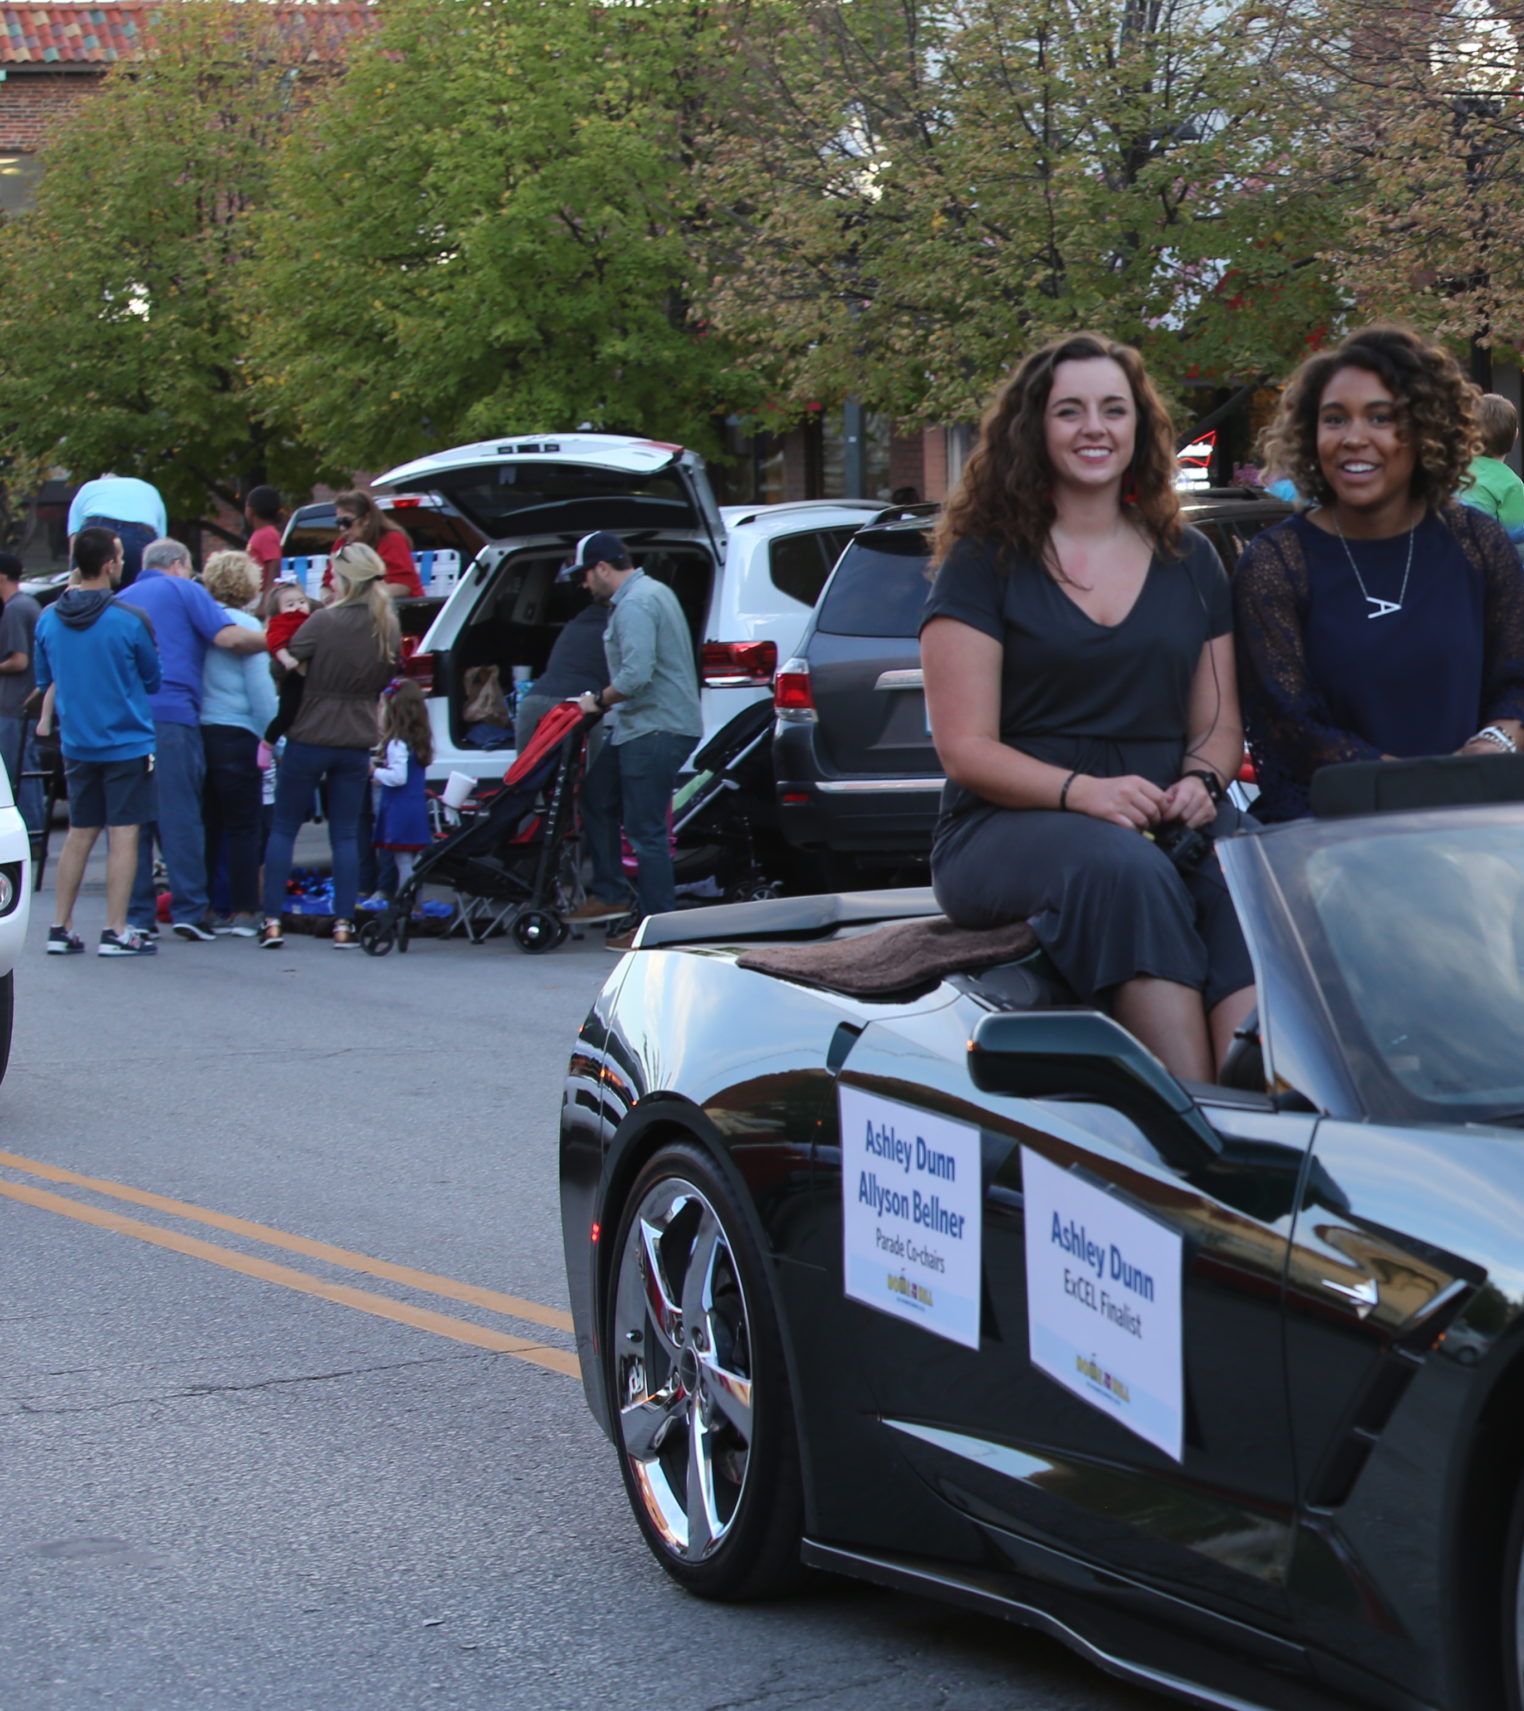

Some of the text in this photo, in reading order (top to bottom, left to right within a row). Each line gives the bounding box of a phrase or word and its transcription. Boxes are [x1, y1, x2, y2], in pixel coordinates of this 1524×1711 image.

[1366, 596, 1402, 619] A
[865, 1119, 956, 1182] Ashley Dunn
[858, 1170, 965, 1240] Allyson Bellner
[875, 1226, 945, 1274] Parade Co-chairs
[1051, 1210, 1154, 1302] Ashley Dunn
[1064, 1267, 1142, 1340] ExCEL Finalist
